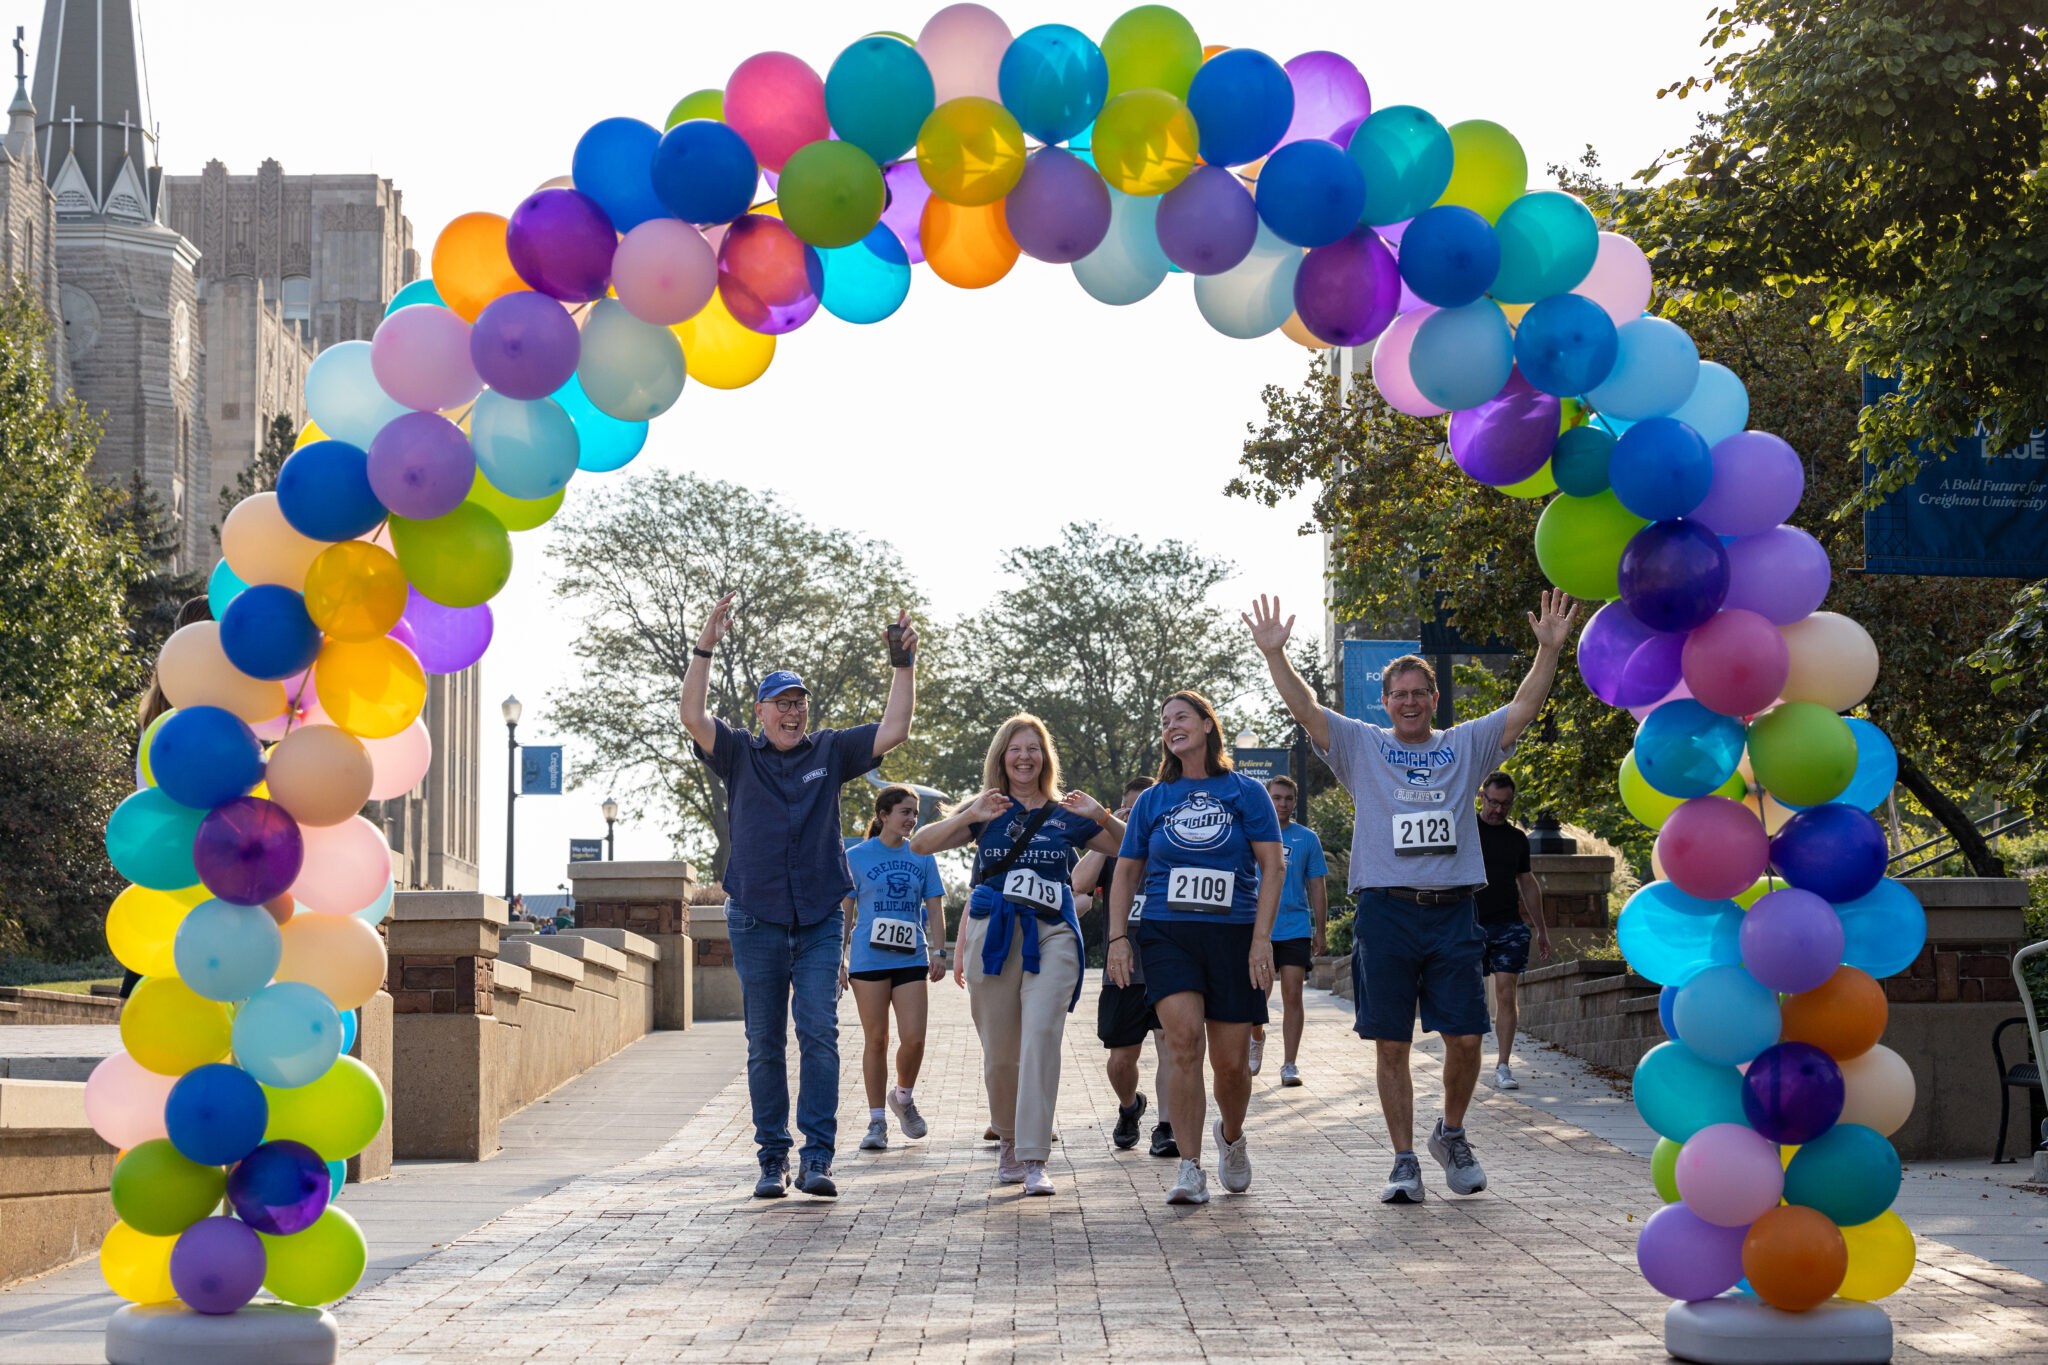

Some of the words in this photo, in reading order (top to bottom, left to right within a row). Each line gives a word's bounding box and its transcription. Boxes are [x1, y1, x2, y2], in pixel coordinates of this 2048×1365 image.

[1939, 478, 1950, 490] A
[1952, 478, 1982, 491] Bold
[1982, 480, 2028, 492] Future
[2024, 480, 2047, 495] for
[1918, 493, 1980, 509] Creighton
[1982, 495, 2047, 511] University
[548, 752, 559, 789] Creighton
[1244, 768, 1269, 776] better,
[1400, 818, 1450, 844] 2123
[984, 848, 1067, 859] CREGHTON
[866, 860, 925, 881] CREIGHTON
[1011, 875, 1056, 904] 2119
[1175, 875, 1227, 902] 2109
[876, 922, 913, 945] 2162
